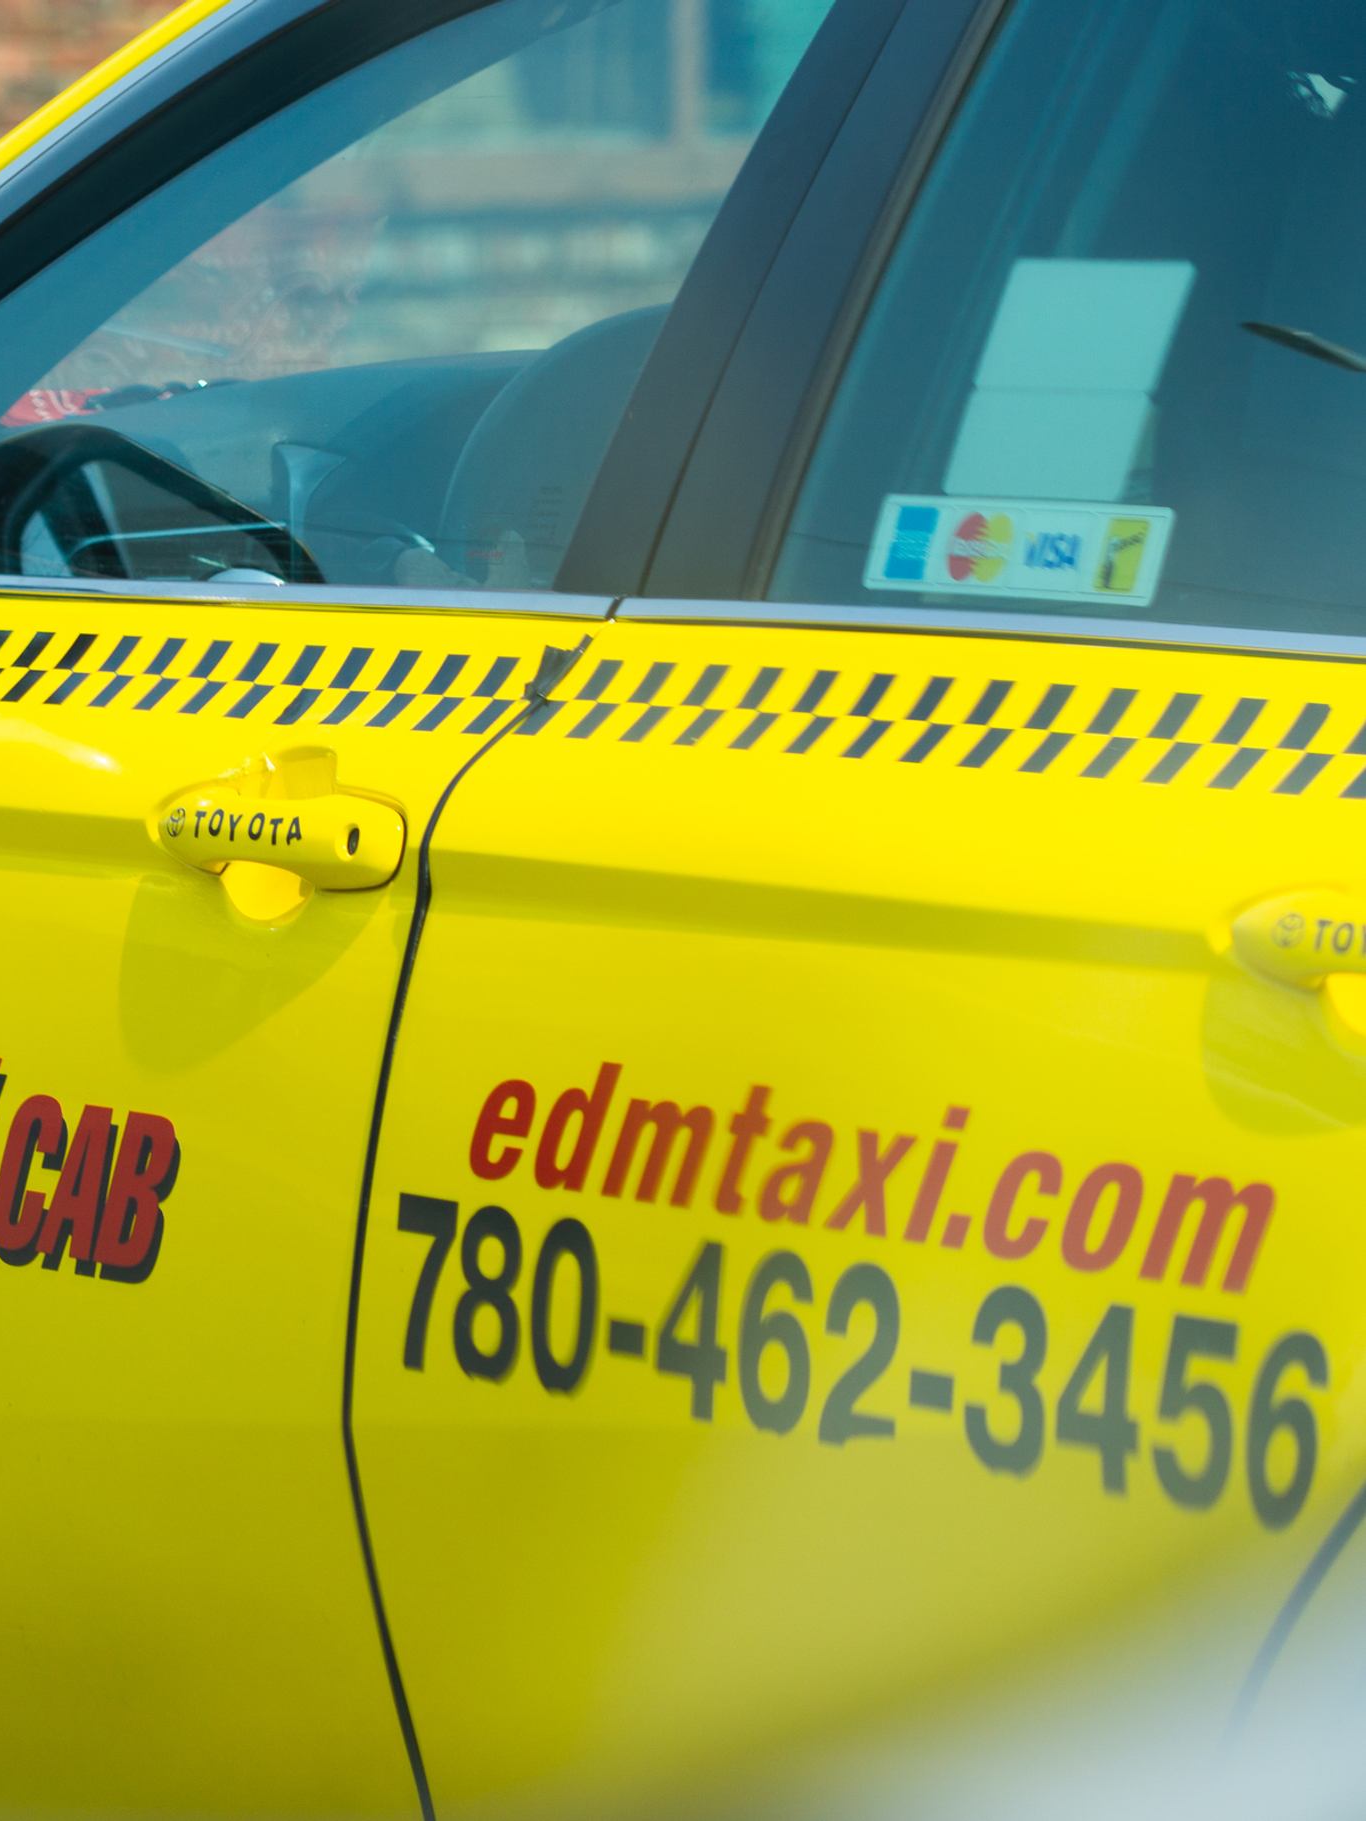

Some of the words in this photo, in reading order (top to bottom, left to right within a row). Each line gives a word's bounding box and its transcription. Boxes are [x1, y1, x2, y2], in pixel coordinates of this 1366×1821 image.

[194, 808, 302, 845] TOYOTA
[468, 1062, 1277, 1295] edmtaxi.com
[397, 1191, 1330, 1533] 780-462-3456
